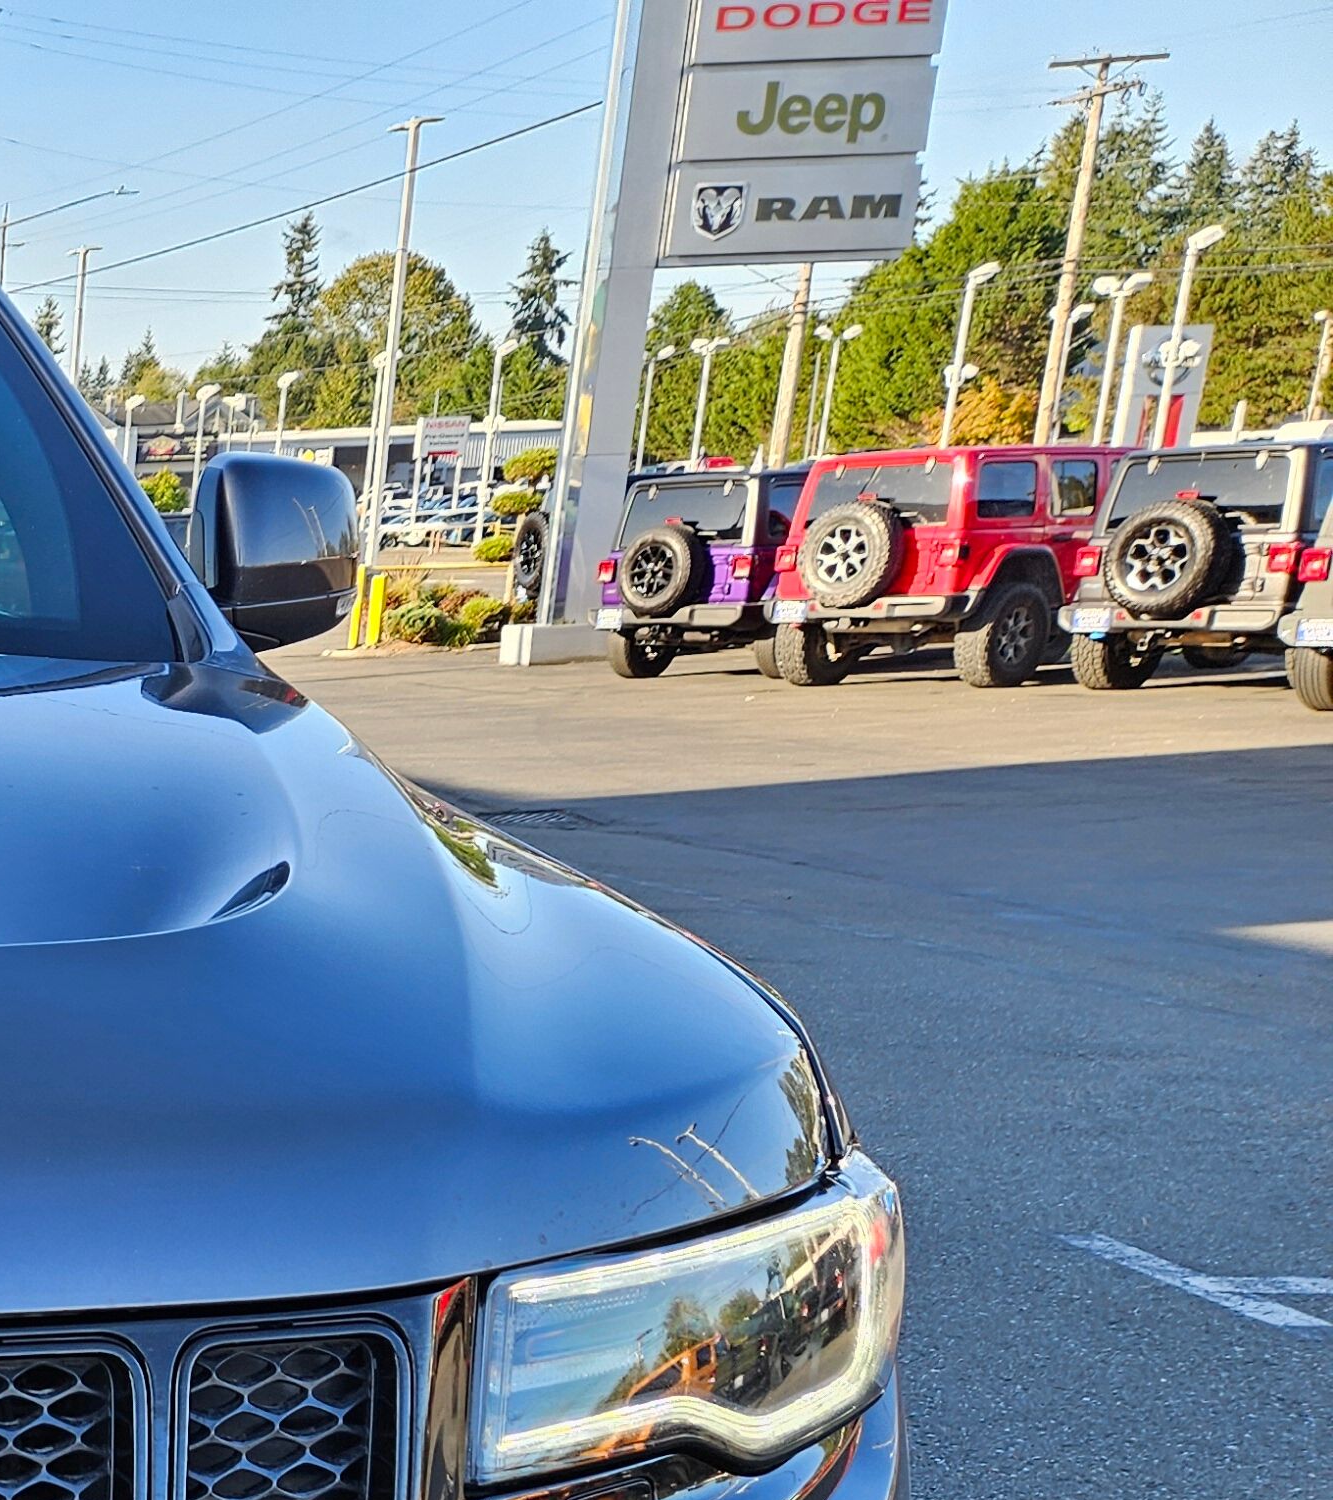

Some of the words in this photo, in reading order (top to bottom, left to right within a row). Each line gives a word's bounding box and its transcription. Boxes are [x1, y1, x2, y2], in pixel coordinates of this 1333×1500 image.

[716, 0, 931, 32] DODGE
[736, 81, 886, 143] Jeep
[755, 194, 902, 222] RAM
